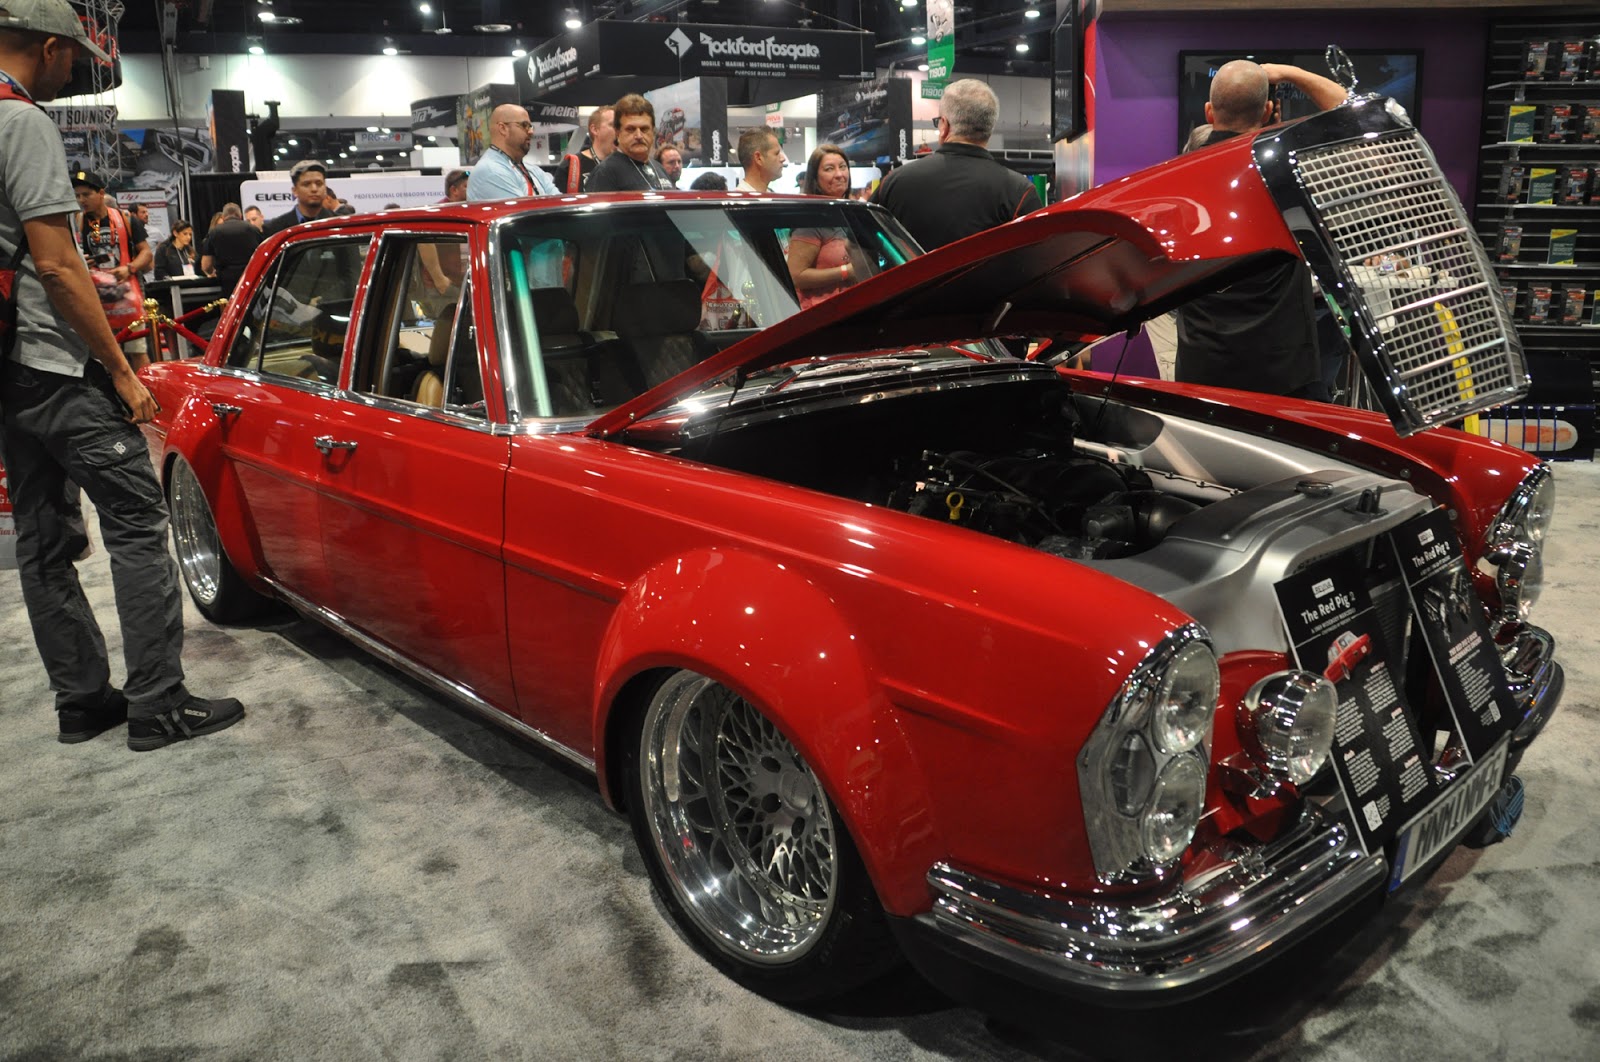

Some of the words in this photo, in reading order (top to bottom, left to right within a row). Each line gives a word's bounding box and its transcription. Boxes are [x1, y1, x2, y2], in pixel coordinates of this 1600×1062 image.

[700, 32, 765, 58] Rockford
[765, 35, 820, 61] Fosgate
[929, 66, 946, 79] 11900
[1412, 555, 1425, 568] The
[1424, 547, 1437, 561] Red
[1435, 543, 1447, 556] Pig
[1301, 609, 1319, 624] The
[1318, 598, 1336, 617] Red
[1334, 593, 1351, 608] Pig
[1349, 591, 1356, 601] 2
